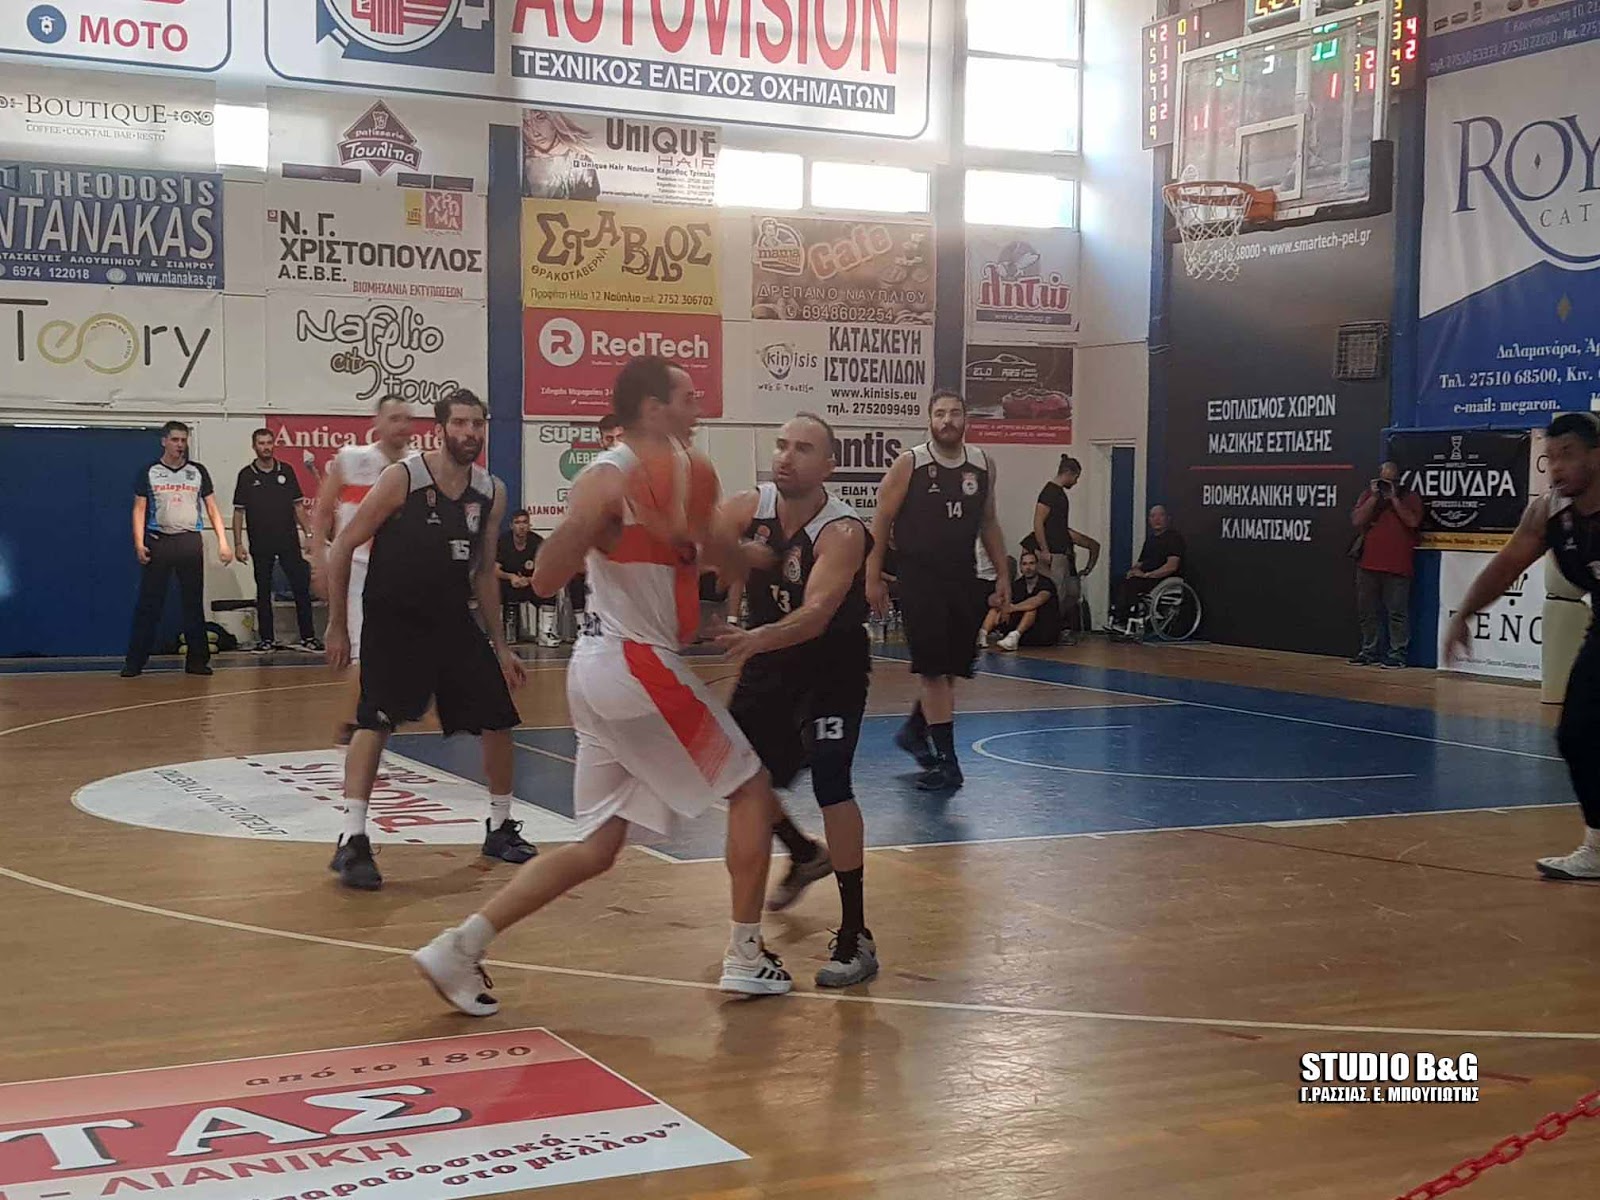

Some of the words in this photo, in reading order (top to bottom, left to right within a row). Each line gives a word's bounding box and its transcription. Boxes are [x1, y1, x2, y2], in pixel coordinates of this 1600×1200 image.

[79, 14, 188, 52] MOTO
[1160, 24, 1168, 41] 2
[519, 49, 642, 86] ΤΕΧΝΙΚΟΣ
[649, 65, 755, 97] ΕΛΕΓΧΟΣ
[760, 77, 889, 110] ΟΧΗΜΑΤΩΝ
[1160, 64, 1168, 81] 3
[26, 94, 167, 126] BOUTIQUE
[1149, 106, 1157, 122] 8
[1160, 103, 1168, 120] 2
[1149, 126, 1157, 140] 9
[658, 156, 715, 170] HAIR
[31, 169, 215, 206] THEODOSIS
[280, 210, 307, 235] Ν.
[317, 212, 336, 237] Γ.
[1540, 204, 1592, 228] CAT
[0, 252, 62, 263] ΤΑΣΚΕΥΕΣ
[70, 255, 142, 266] ΑΛΟΥΜΙΝΙΟΥ
[166, 260, 215, 270] ΣΙΔΗΡΟΥ
[280, 237, 482, 273] ΧΡΙΣΤΟΠΟΥΛΟΣ
[13, 265, 41, 278] 6974
[49, 267, 90, 280] 122018
[136, 270, 217, 288] www.ntanakas.gr
[278, 265, 347, 282] Α.Ε.Β.Ε.
[353, 281, 407, 296] ΒΙΟΜΗΧΑΝΙΑ
[409, 284, 463, 298] ΕΚΤΥΠΩΣΕΩΝ
[658, 293, 679, 305] 2752
[682, 294, 713, 306] 306702
[758, 285, 838, 300] ΔΡΕΠΑΝΟ
[847, 289, 926, 303] ΝΑΥΠΛΙΟΥ
[802, 305, 893, 321] 6948602254
[591, 330, 709, 359] RedTech
[829, 326, 922, 355] ΚΑΤΑΣΚΕΥΗ
[824, 357, 926, 385] ΙΣΤΟΣΕΛΙΔΩΝ
[1439, 373, 1466, 389] Τηλ.
[1469, 371, 1511, 387] 27510
[1514, 367, 1562, 385] 68500,
[1566, 366, 1594, 382] Κιν.
[831, 387, 918, 401] www.kinisis.eu
[827, 405, 849, 416] τηλ.
[853, 403, 920, 416] 2752099499
[1207, 397, 1285, 421] ΕΞΟΠΛΙΣΜΟΣ
[1288, 394, 1336, 418] ΧΩΡΩΝ
[1454, 397, 1496, 414] e-mail:
[1500, 399, 1561, 415] megaron.
[274, 425, 356, 448] Antica
[1208, 432, 1264, 454] ΜΑΖΙΚΗΣ
[1266, 430, 1333, 453] ΕΣΤΙΑΣΗΣ
[842, 486, 868, 496] ΕΙΔΗ
[1202, 485, 1293, 506] ΒΙΟΜΗΧΑΝΙΚΗ
[1296, 485, 1337, 507] ΨΥΞΗ
[946, 501, 963, 518] 14
[1222, 518, 1312, 541] ΚΛΙΜΑΤΙΣΜΟΣ
[449, 540, 470, 560] 15
[814, 716, 844, 740] 13
[246, 1067, 336, 1086] από
[351, 1062, 397, 1074] το
[417, 1046, 532, 1067] 1890
[101, 1142, 412, 1196] ΛΙΑΝΙΚΗ
[442, 1164, 518, 1186] στο
